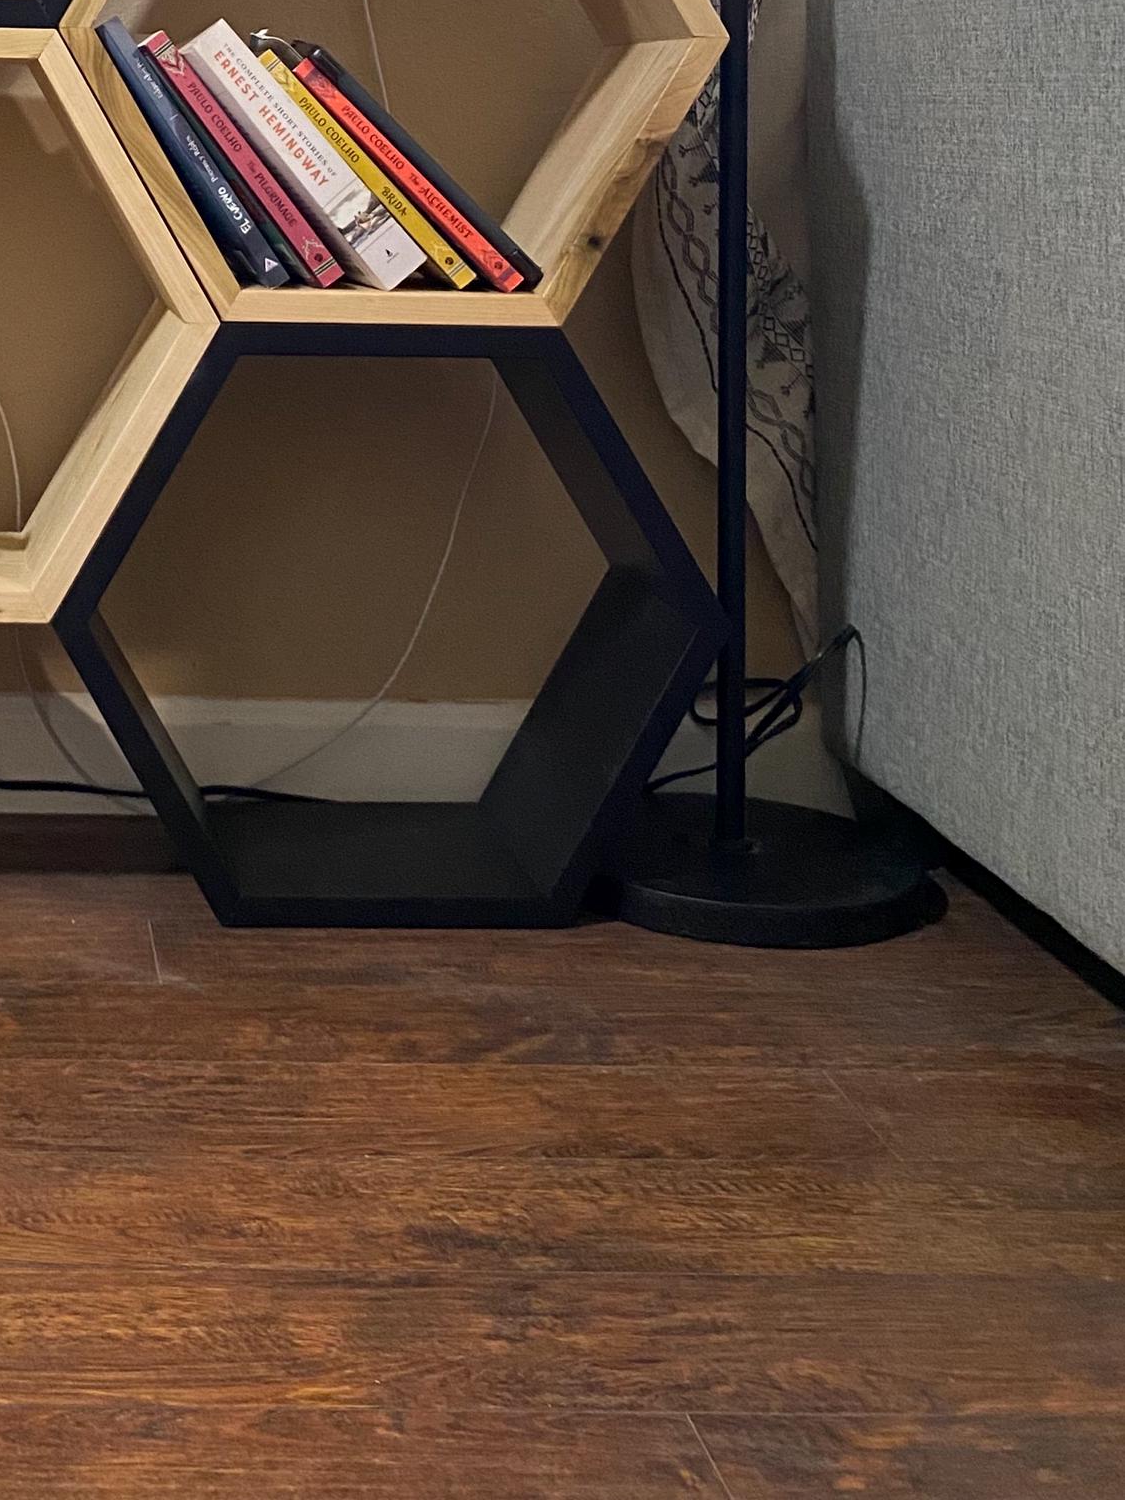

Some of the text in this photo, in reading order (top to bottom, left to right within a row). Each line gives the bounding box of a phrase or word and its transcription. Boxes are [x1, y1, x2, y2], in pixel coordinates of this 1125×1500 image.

[187, 82, 242, 153] PAULO COELHO
[214, 51, 329, 186] ERNEST HEMINGWAY
[236, 58, 274, 102] COMPLETE
[274, 103, 299, 130] SHORT
[298, 131, 327, 165] STORIES
[299, 97, 360, 163] PAULO COELHO
[341, 105, 405, 170] PAULO COELHO
[217, 186, 251, 234] EL CUERVO
[254, 172, 297, 227] PILGRIMAGE
[381, 186, 407, 217] BRIDA
[418, 187, 474, 239] ALCHEMIST
